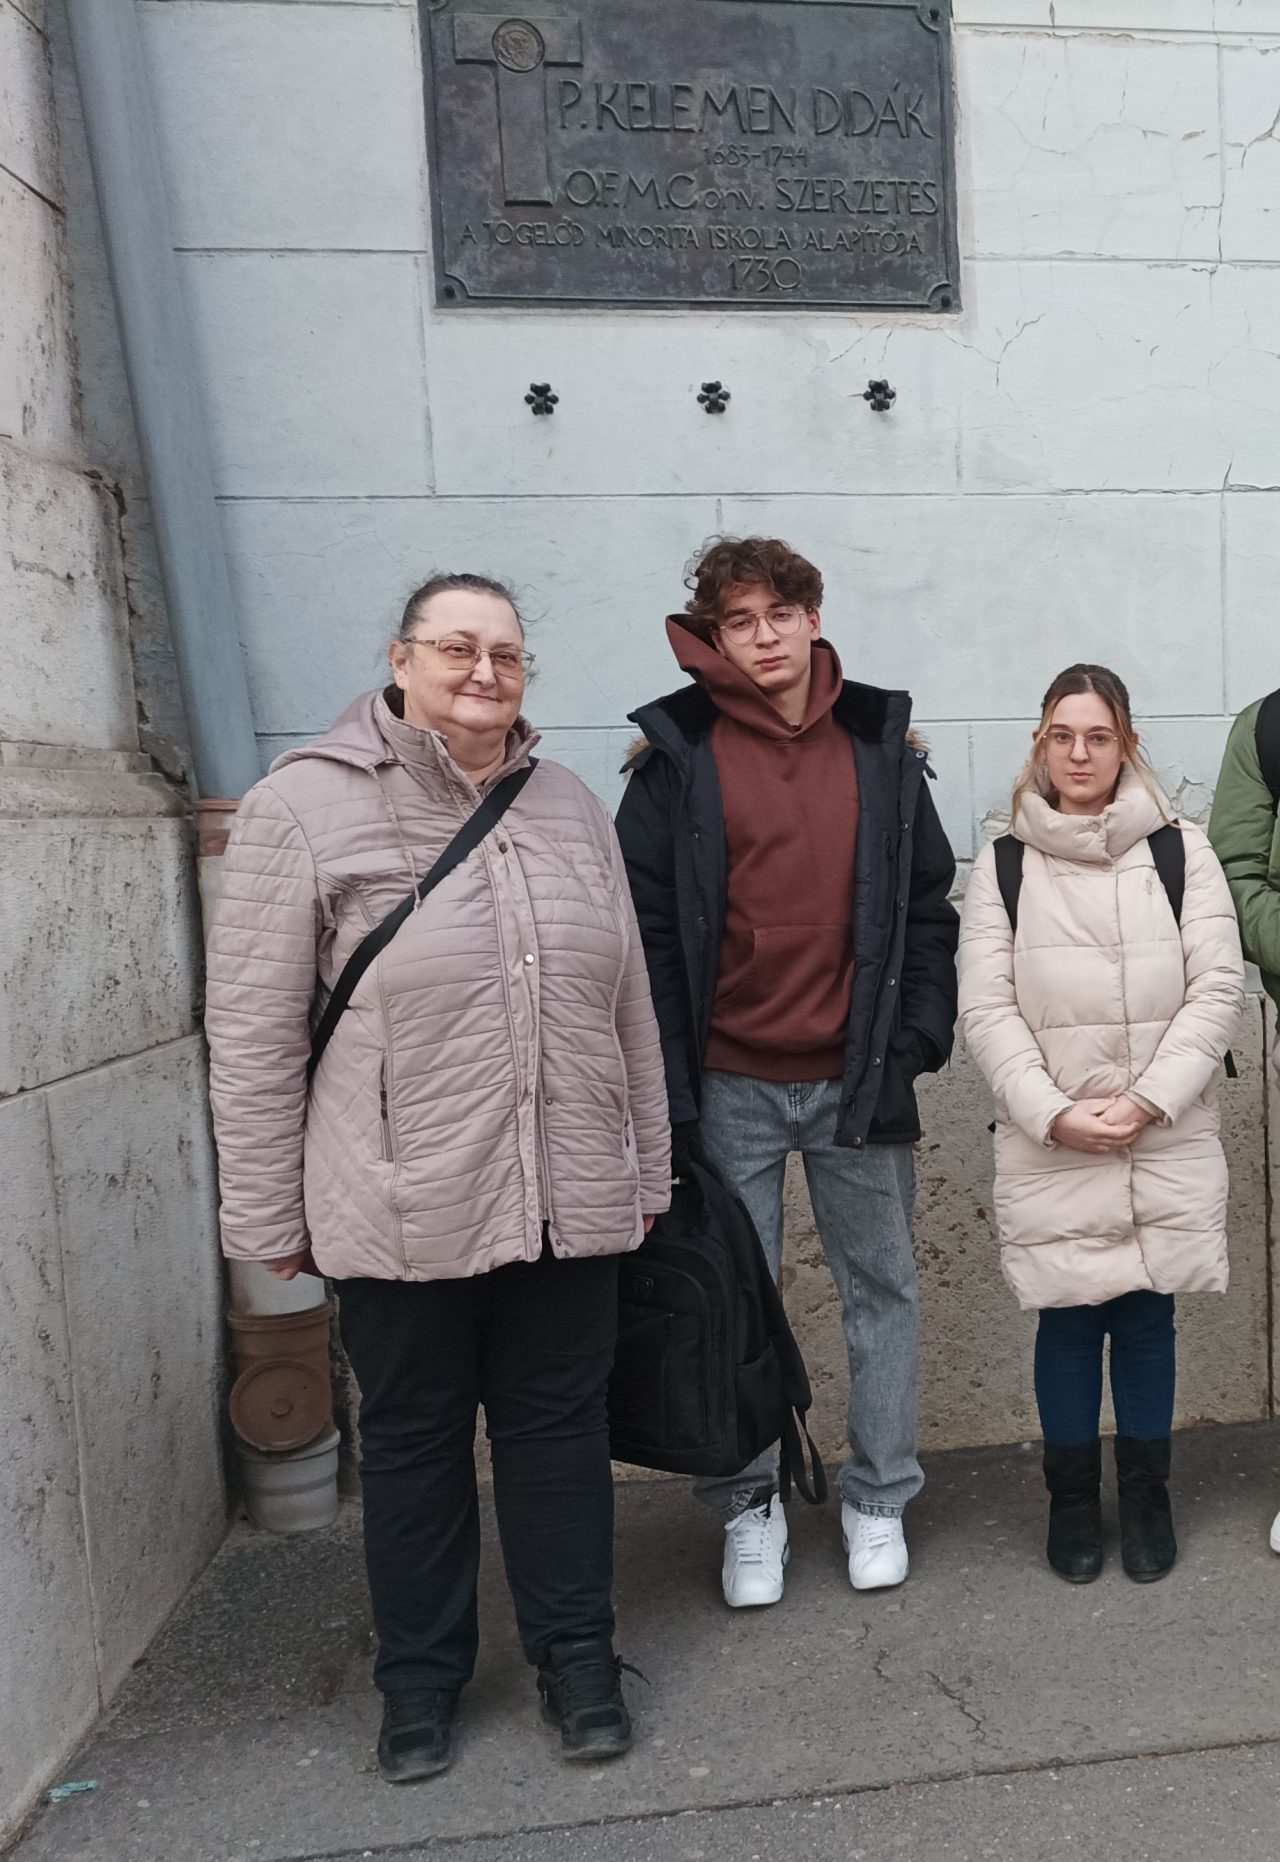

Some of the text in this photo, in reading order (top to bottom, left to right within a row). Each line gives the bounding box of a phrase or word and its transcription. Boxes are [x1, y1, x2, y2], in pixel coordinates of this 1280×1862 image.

[812, 80, 935, 140] DIDÁK
[703, 143, 810, 169] 1683-1744
[774, 177, 940, 216] SZERZETES
[459, 223, 478, 246] A
[595, 222, 700, 249] MINORITA
[708, 224, 793, 251] ISKOLA
[727, 254, 803, 292] 1730
